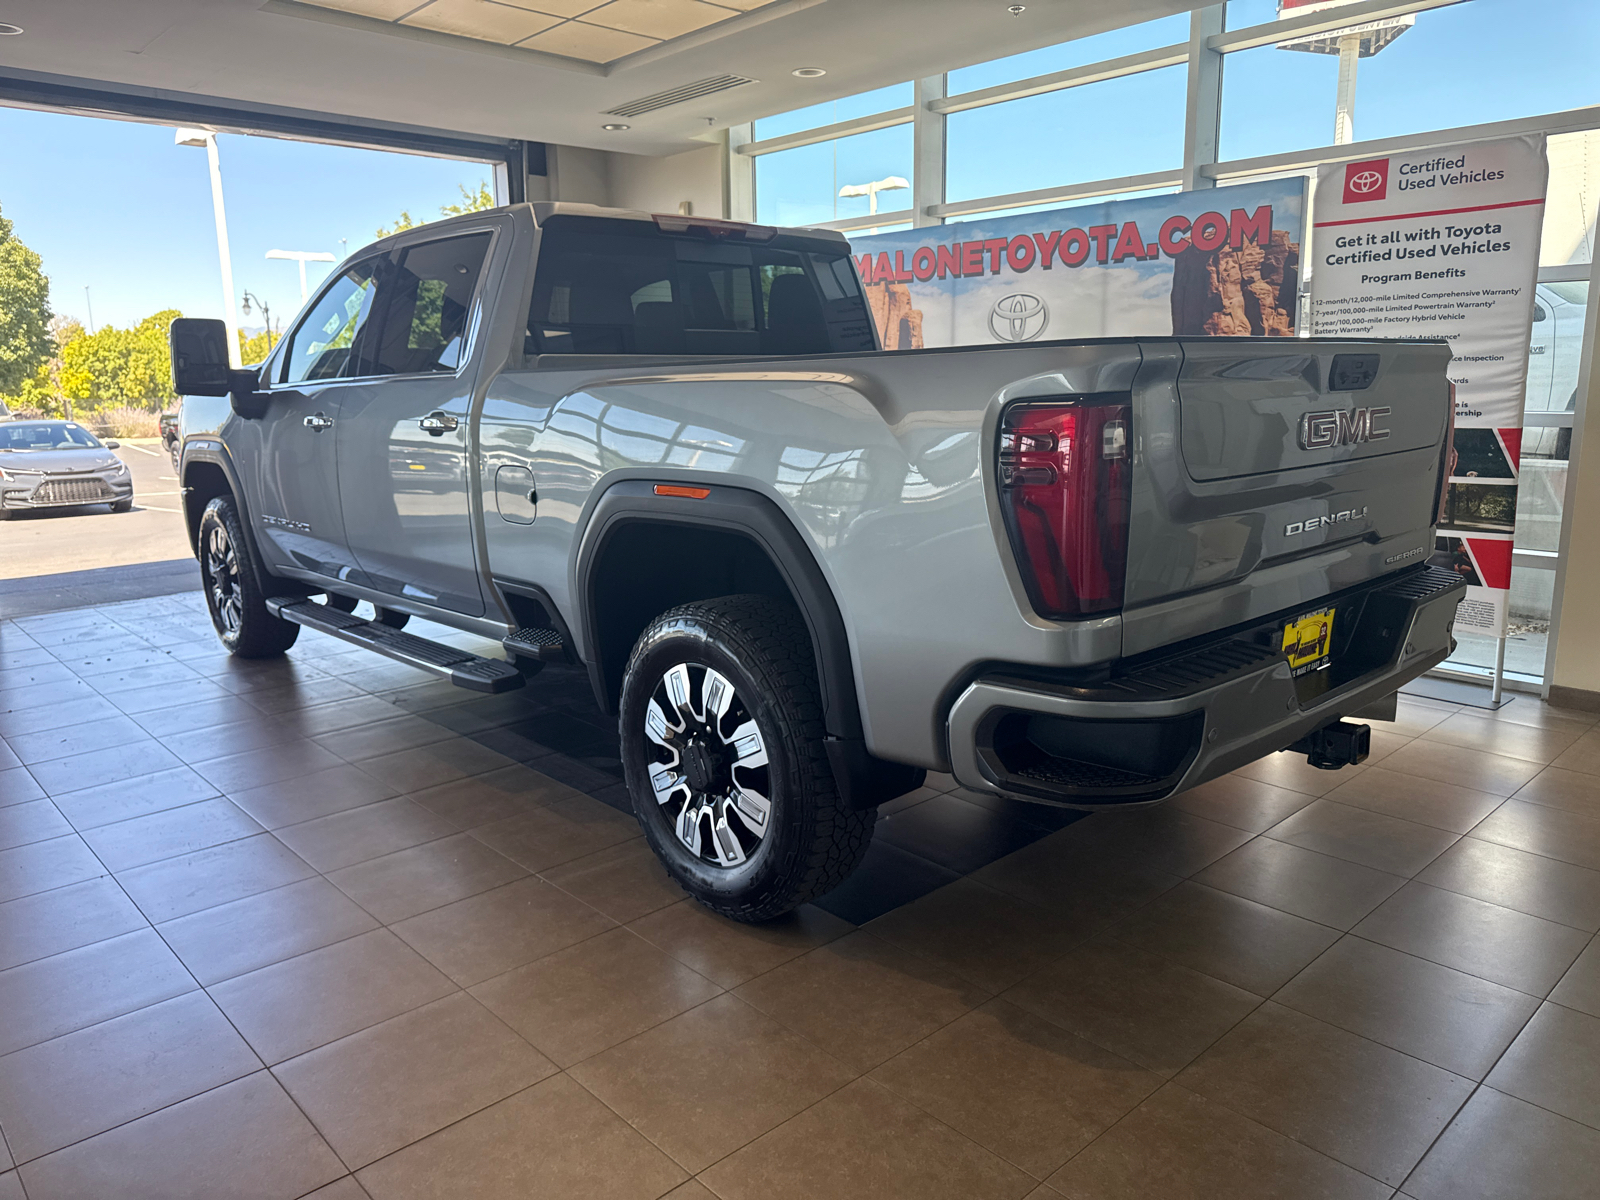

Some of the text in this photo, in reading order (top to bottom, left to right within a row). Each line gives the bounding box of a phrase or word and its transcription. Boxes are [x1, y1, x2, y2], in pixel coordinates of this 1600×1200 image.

[1399, 155, 1465, 175] Certified
[1398, 168, 1505, 191] Used Vehicles
[853, 205, 1274, 286] MALONETOYOTA.COM
[1335, 223, 1502, 248] Get it all with Toyota
[1325, 239, 1511, 266] Certified Used Vehicles
[1361, 267, 1466, 284] Program Benefits
[1316, 295, 1391, 305] 12-month/12,000-mile
[1393, 292, 1420, 300] Limited
[1421, 289, 1480, 299] Comprehensive
[1315, 306, 1384, 317] 7-year/100,000-mile
[1385, 303, 1413, 312] Limited
[1414, 302, 1454, 310] Powertrain
[1315, 312, 1465, 327] 8-year/100,000-mile Factory Hybrid Vehicle
[1464, 355, 1505, 363] Inspection
[1299, 406, 1392, 450] GMC
[1284, 506, 1368, 537] DENALI
[1386, 547, 1424, 565] SIERRA
